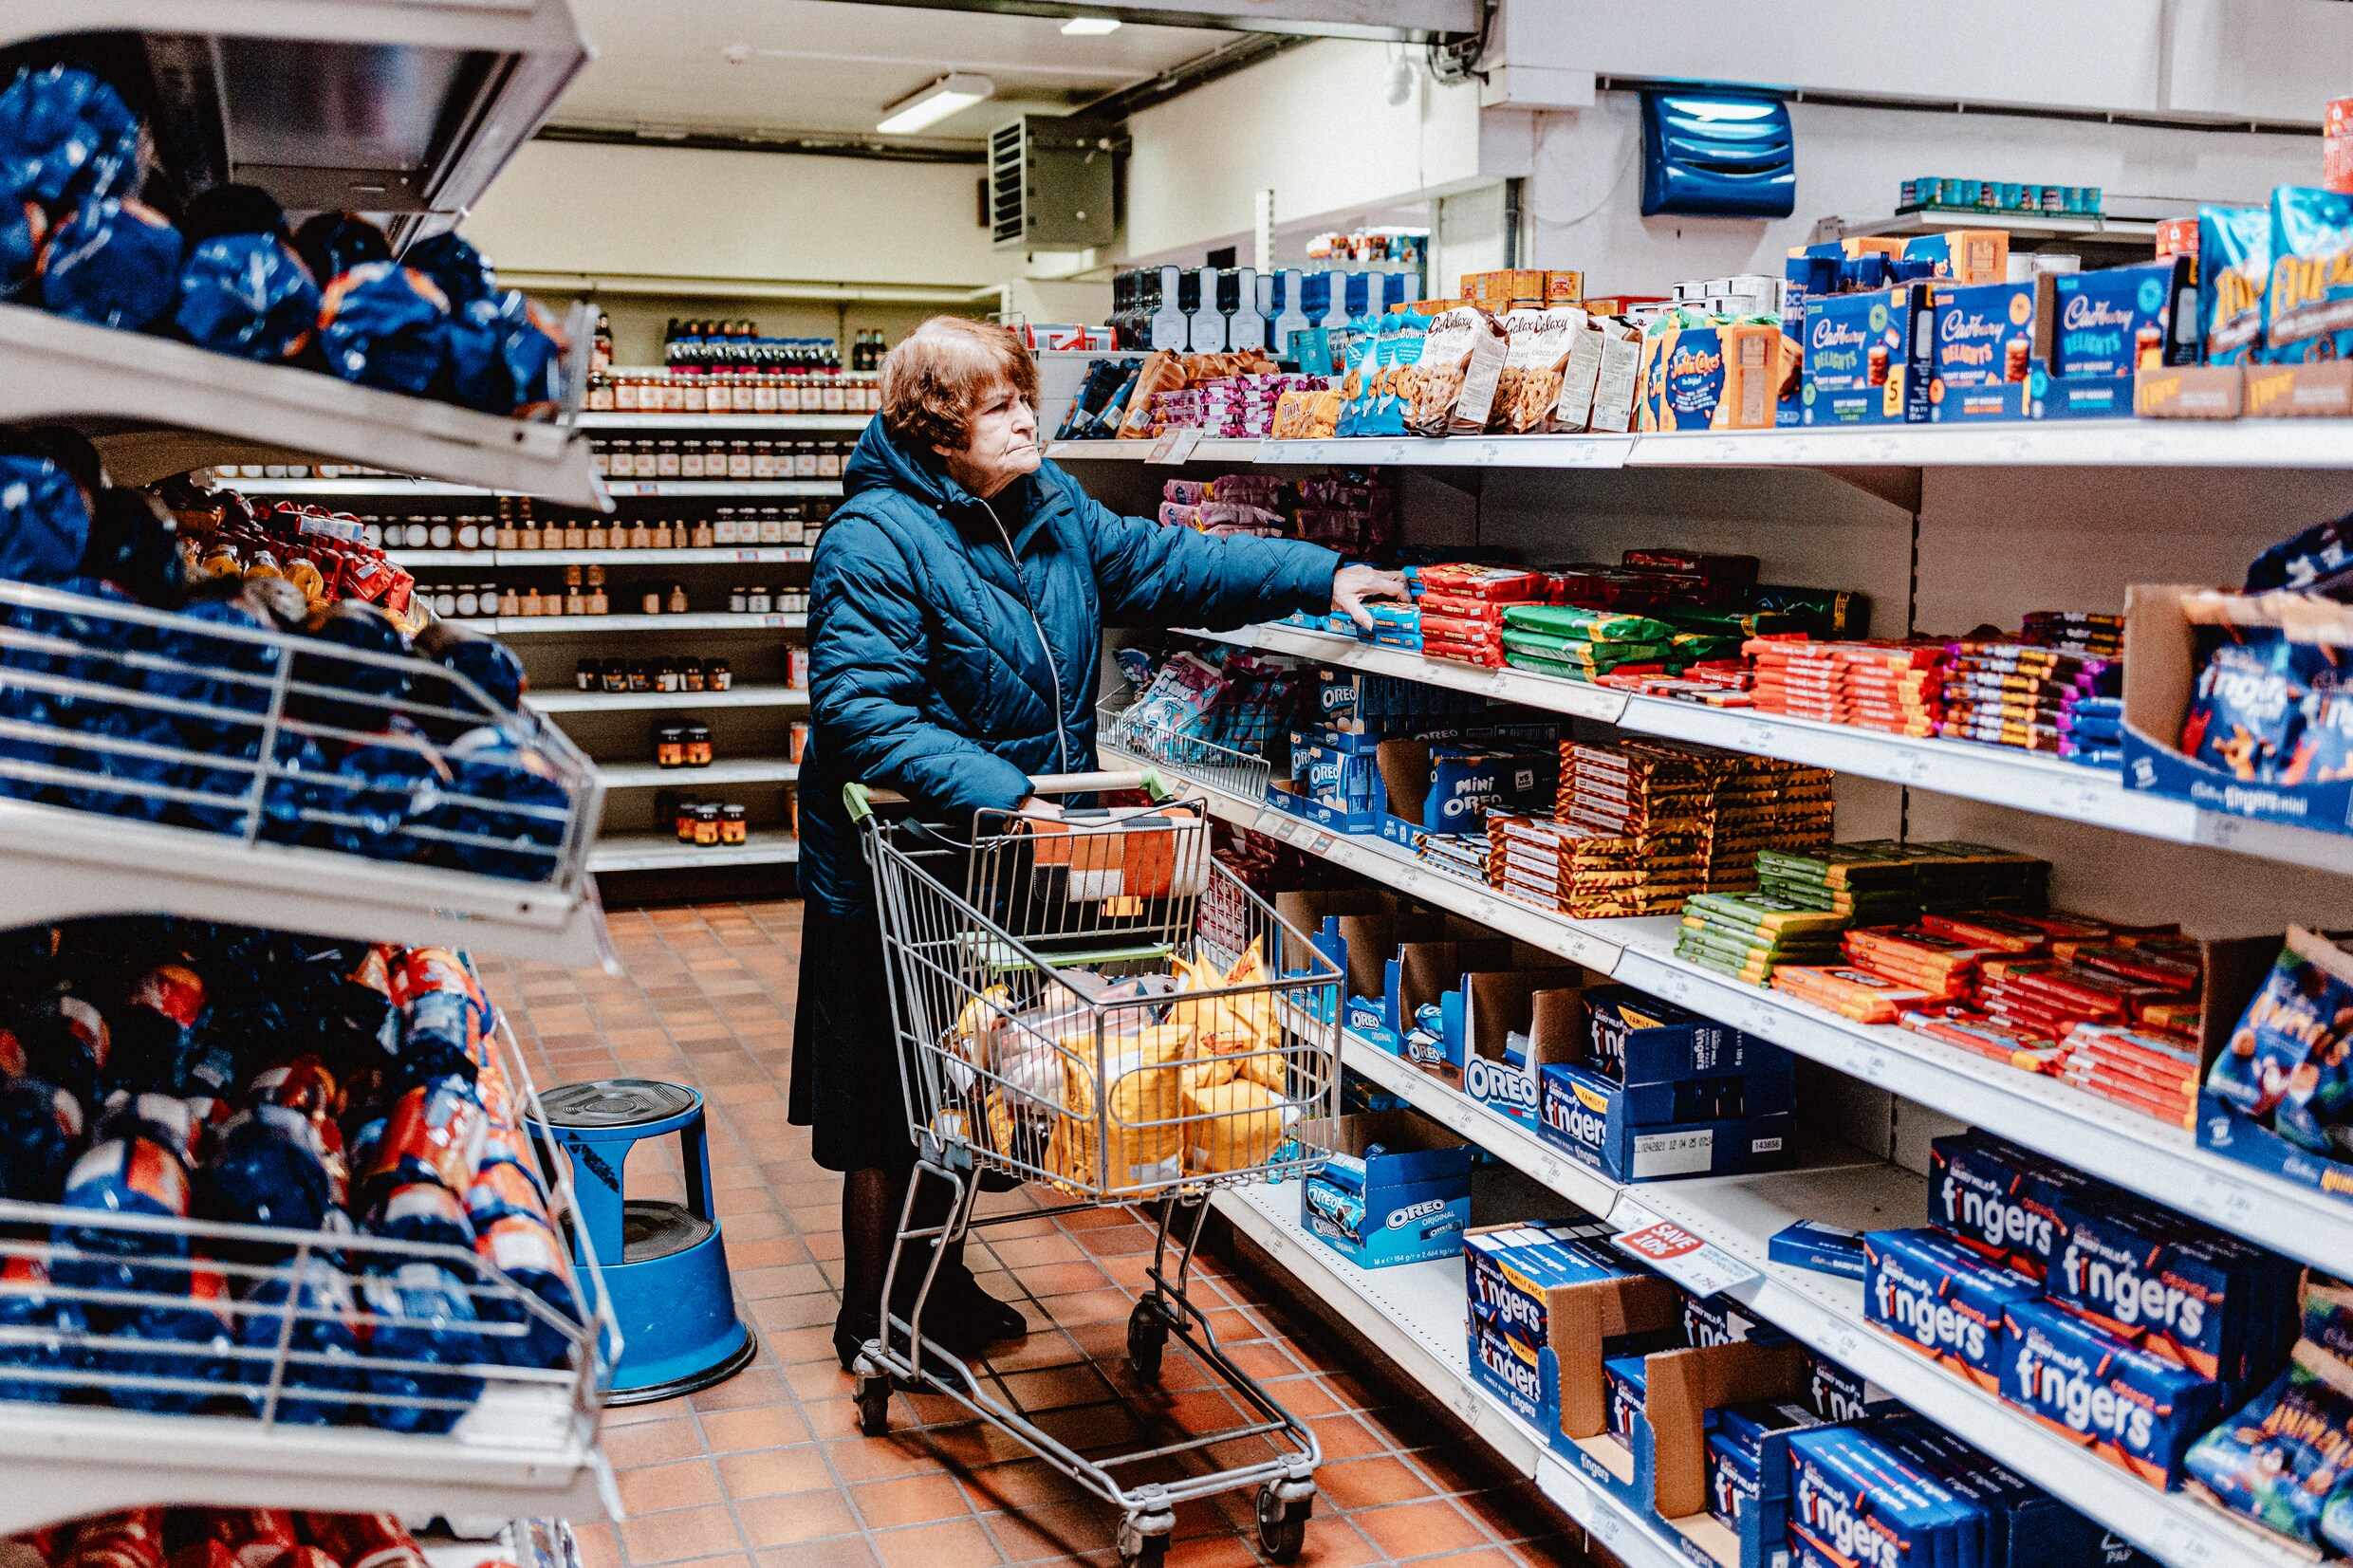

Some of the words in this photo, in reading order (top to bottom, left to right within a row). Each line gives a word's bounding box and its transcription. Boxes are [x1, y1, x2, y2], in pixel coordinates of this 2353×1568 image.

[1445, 311, 1473, 332] Galaxy
[2064, 295, 2134, 332] Cadbury
[1534, 315, 1567, 339] Galaxy
[1812, 318, 1867, 350] Cadbury
[1941, 309, 2005, 343] Cadbury
[1941, 343, 1992, 365] DELIGHTS
[2064, 332, 2121, 356] DELIGHTS
[1813, 351, 1858, 371] DELIGHTS
[1889, 380, 1898, 402] 5
[1323, 688, 1357, 709] OREO
[1293, 753, 1310, 770] OR
[1310, 764, 1339, 784] OREO
[1441, 794, 1502, 818] OREO
[1351, 1010, 1380, 1030] OREO
[1628, 1015, 1650, 1028] FAMILY
[1371, 1032, 1392, 1042] ORIGINAL
[1409, 1042, 1440, 1063] OREO
[1467, 1060, 1537, 1107] OREO
[1582, 1092, 1601, 1106] FAMILY
[1574, 1145, 1602, 1167] fingers
[1306, 1185, 1340, 1210] OREO
[1386, 1198, 1446, 1230] OREO
[1422, 1210, 1455, 1227] ORIGINAL
[1941, 1176, 2053, 1256] fingers
[1311, 1216, 1342, 1241] OREO
[1651, 1223, 1699, 1249] SAVE
[1335, 1241, 1356, 1254] ORIGINAL
[1632, 1234, 1674, 1256] 10%
[1394, 1254, 1404, 1263] 154
[1508, 1271, 1528, 1287] FAMILY
[1528, 1282, 1542, 1297] PACK
[2063, 1245, 2205, 1338] fingers
[1475, 1267, 1541, 1332] fingers
[1875, 1274, 1985, 1360] fingers
[1513, 1341, 1529, 1357] FAMILY
[1483, 1373, 1497, 1388] FAMILY
[1498, 1384, 1510, 1396] PACK
[1510, 1392, 1536, 1418] fingers
[1834, 1376, 1856, 1394] MILK
[2016, 1348, 2153, 1450] fingers
[1581, 1453, 1609, 1483] fingers
[1799, 1477, 1898, 1568] fingers
